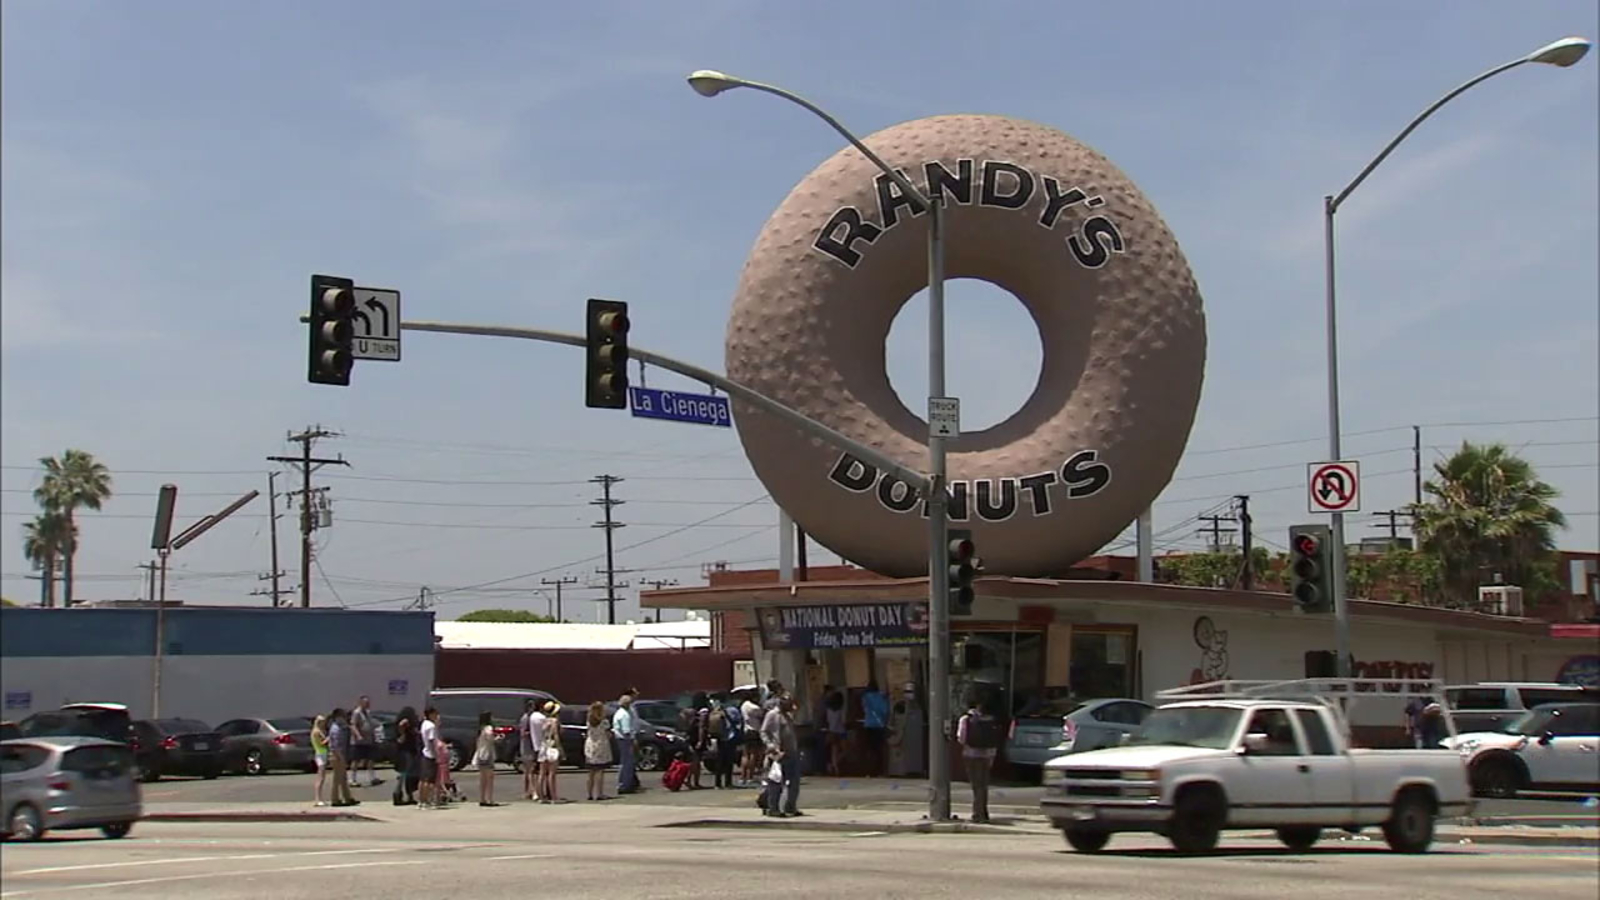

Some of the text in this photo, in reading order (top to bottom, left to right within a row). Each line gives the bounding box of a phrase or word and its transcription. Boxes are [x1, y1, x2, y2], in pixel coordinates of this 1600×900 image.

[813, 159, 1125, 269] RANDY'S
[631, 388, 728, 425] La Cienega
[828, 450, 1111, 522] DONUTS
[783, 605, 902, 628] NATIONAL DONUT DAY
